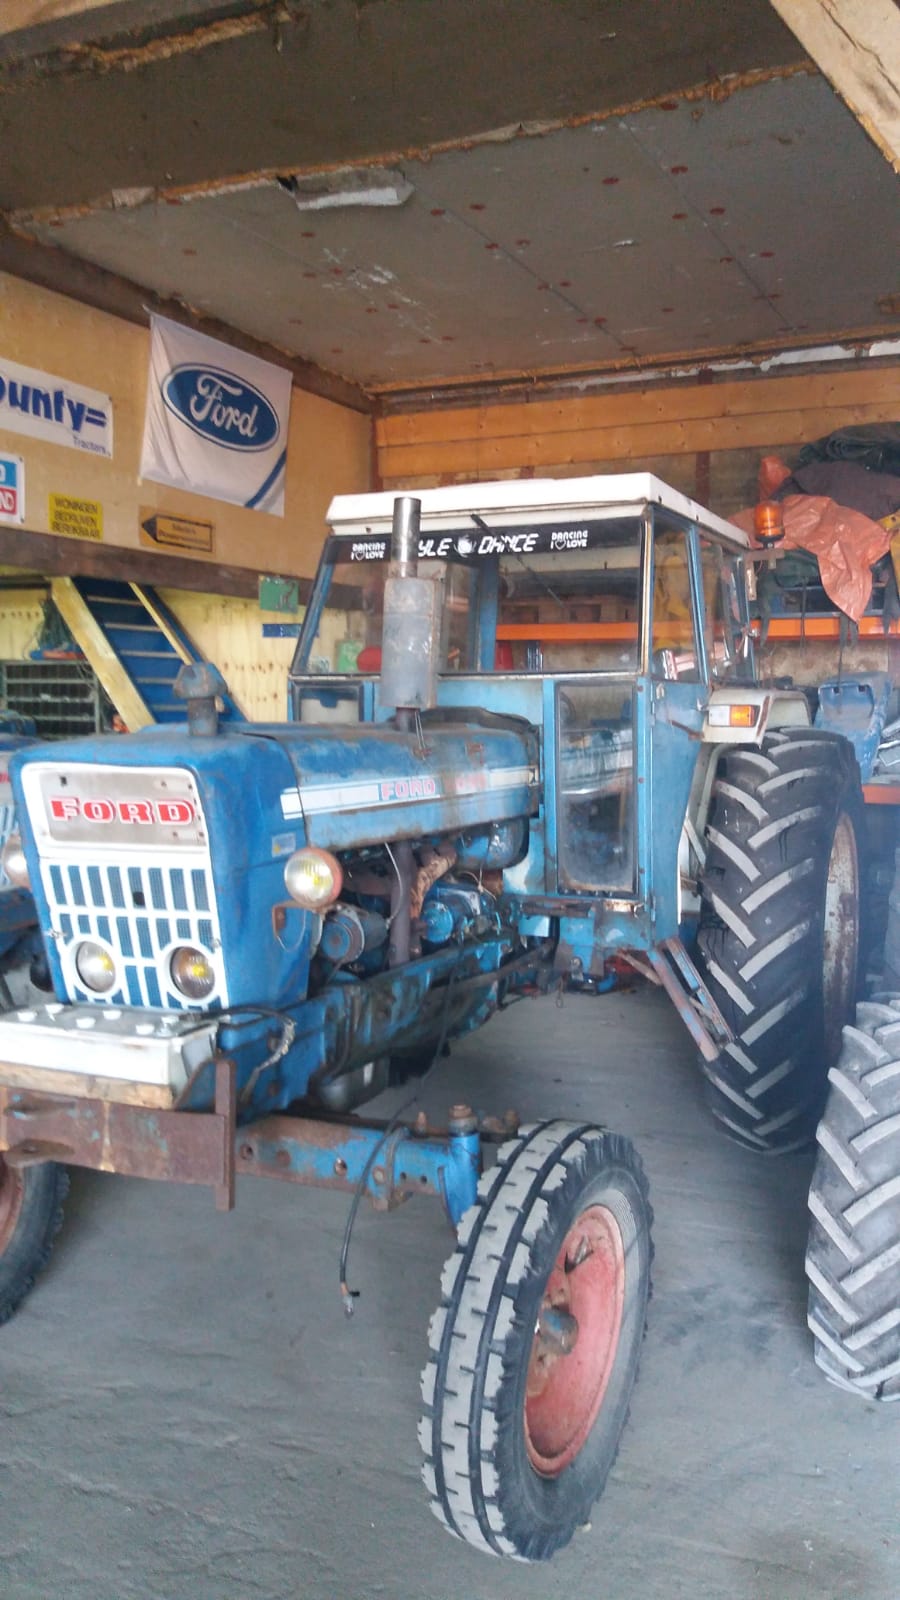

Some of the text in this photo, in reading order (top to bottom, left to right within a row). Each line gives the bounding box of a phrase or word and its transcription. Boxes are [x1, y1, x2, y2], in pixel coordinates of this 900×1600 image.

[189, 374, 259, 438] Ford
[478, 533, 540, 554] DANCE
[566, 538, 587, 549] LOVE
[365, 550, 384, 560] LOVE
[380, 779, 437, 801] FORD
[50, 797, 195, 825] FORD
